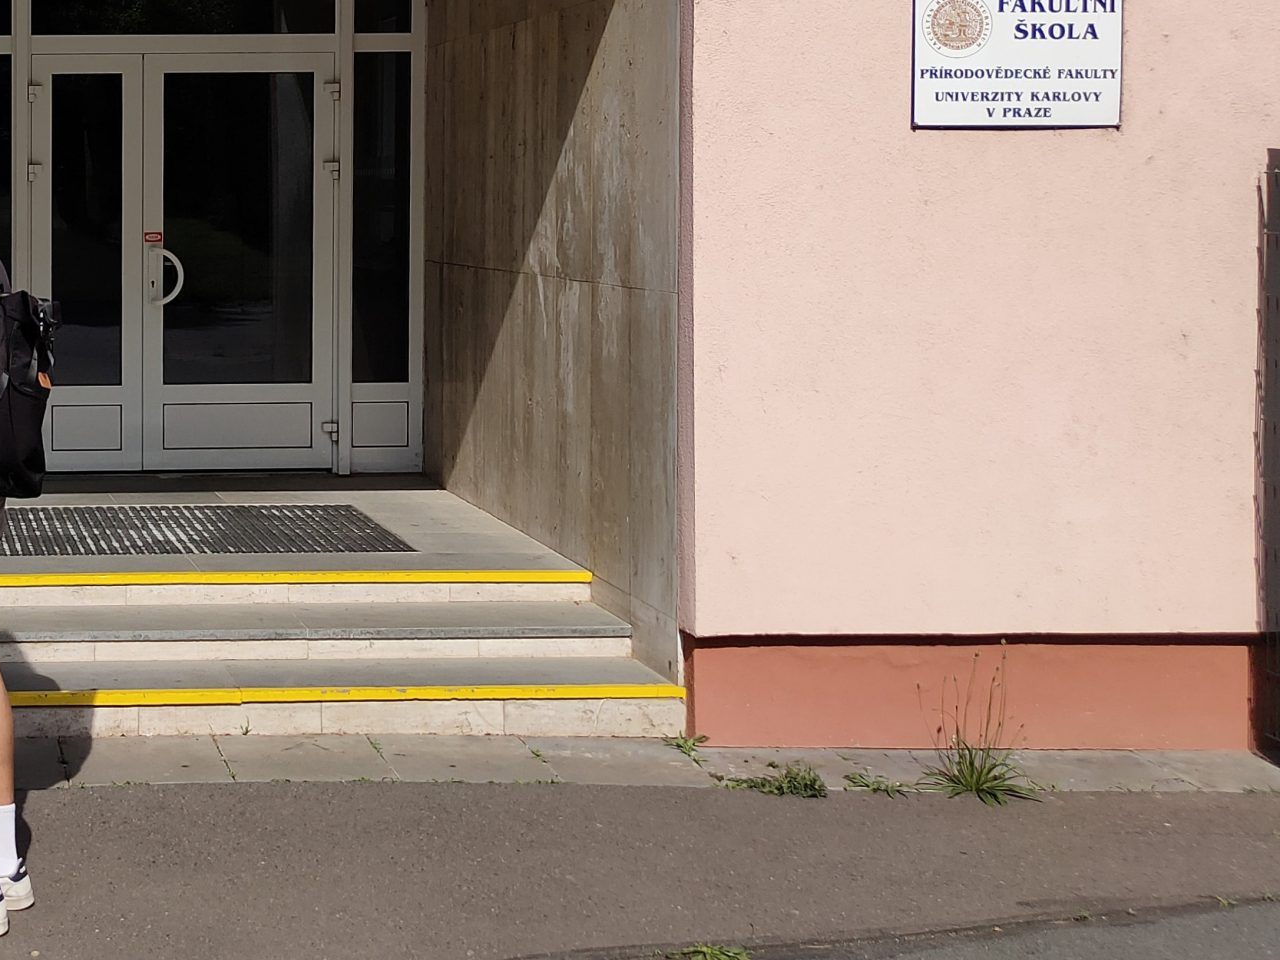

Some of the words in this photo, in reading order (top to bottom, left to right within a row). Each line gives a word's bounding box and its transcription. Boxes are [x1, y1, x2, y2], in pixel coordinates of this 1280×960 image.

[1014, 18, 1099, 41] ŠKOLA
[919, 66, 1051, 80] PŘÍRODOVĚDECKÉ
[1057, 68, 1118, 80] FAKULTY
[934, 91, 1024, 102] UNIVERZITY
[1030, 91, 1103, 102] KARLOVY
[986, 107, 996, 118] V
[1002, 107, 1052, 118] PRAZE
